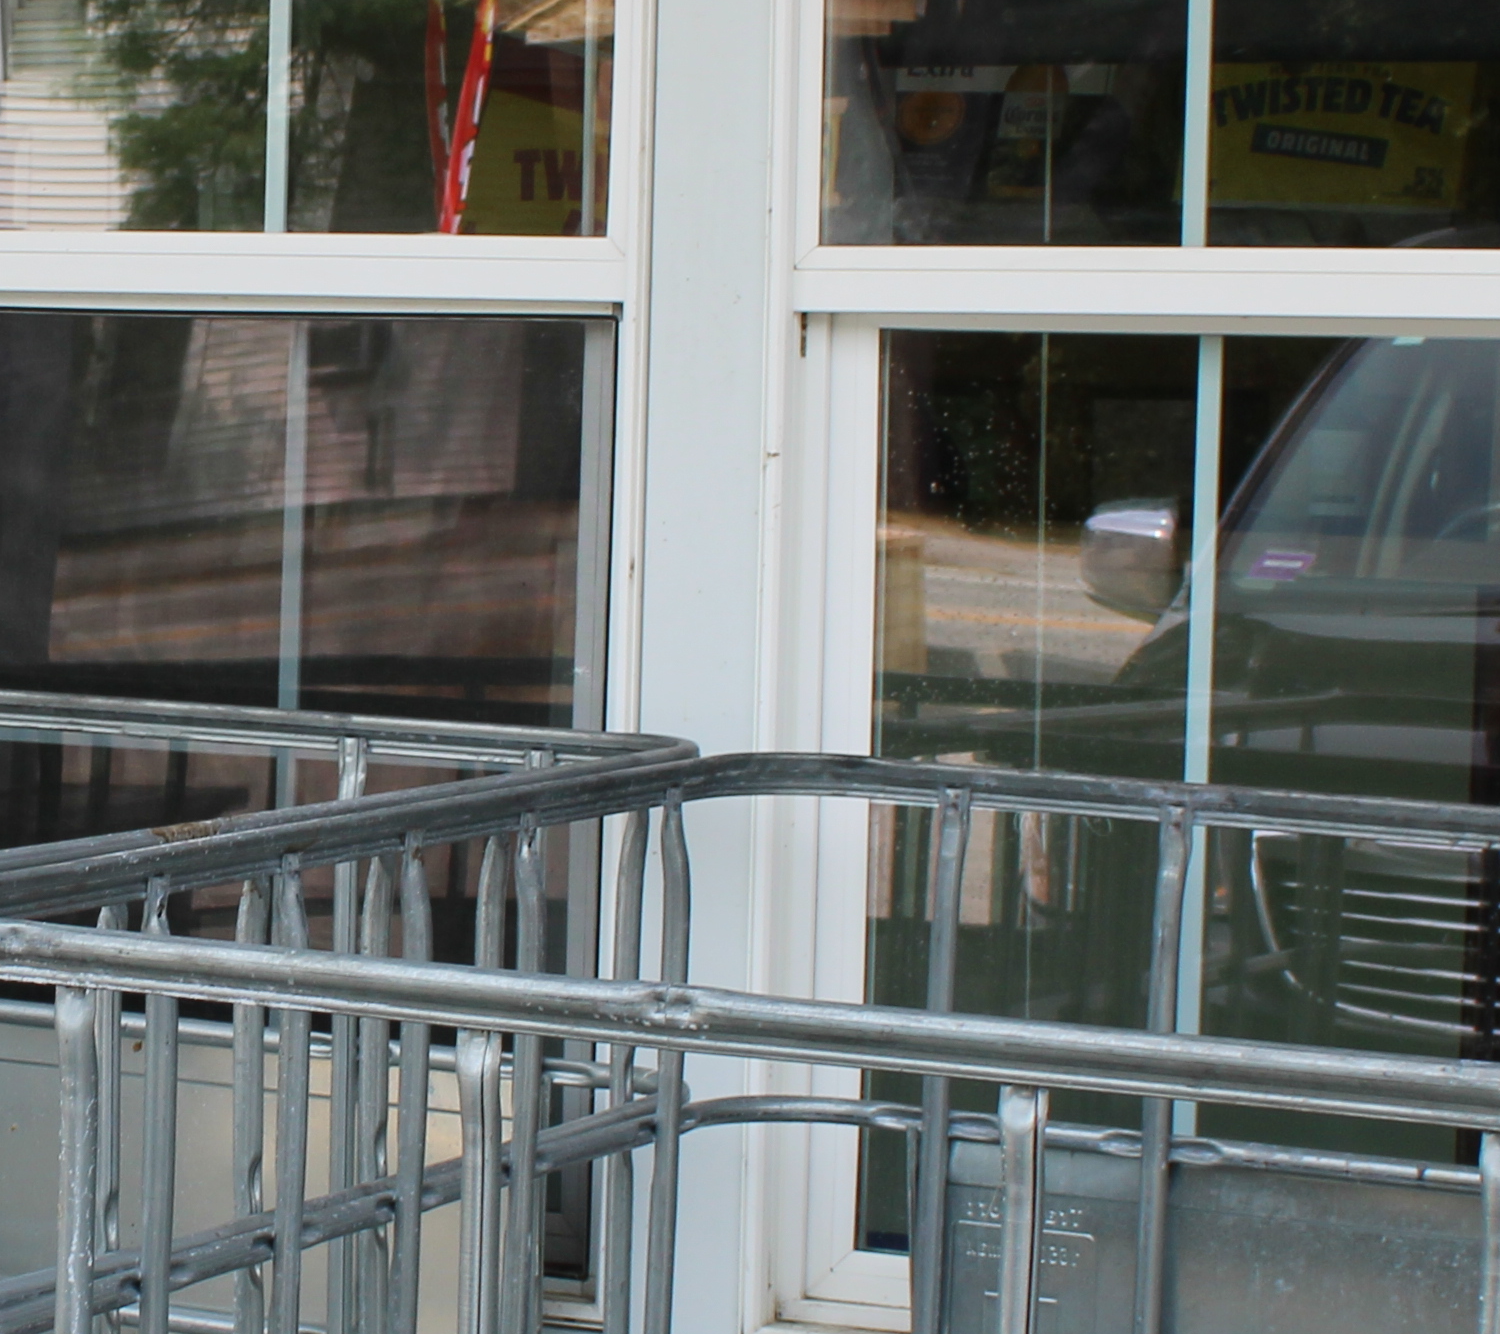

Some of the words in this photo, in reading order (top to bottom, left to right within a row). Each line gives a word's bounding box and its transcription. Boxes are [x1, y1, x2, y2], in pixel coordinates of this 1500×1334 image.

[1214, 75, 1373, 128] TWISTED
[1379, 81, 1447, 135] TEA
[1265, 130, 1370, 162] ORIGINAL
